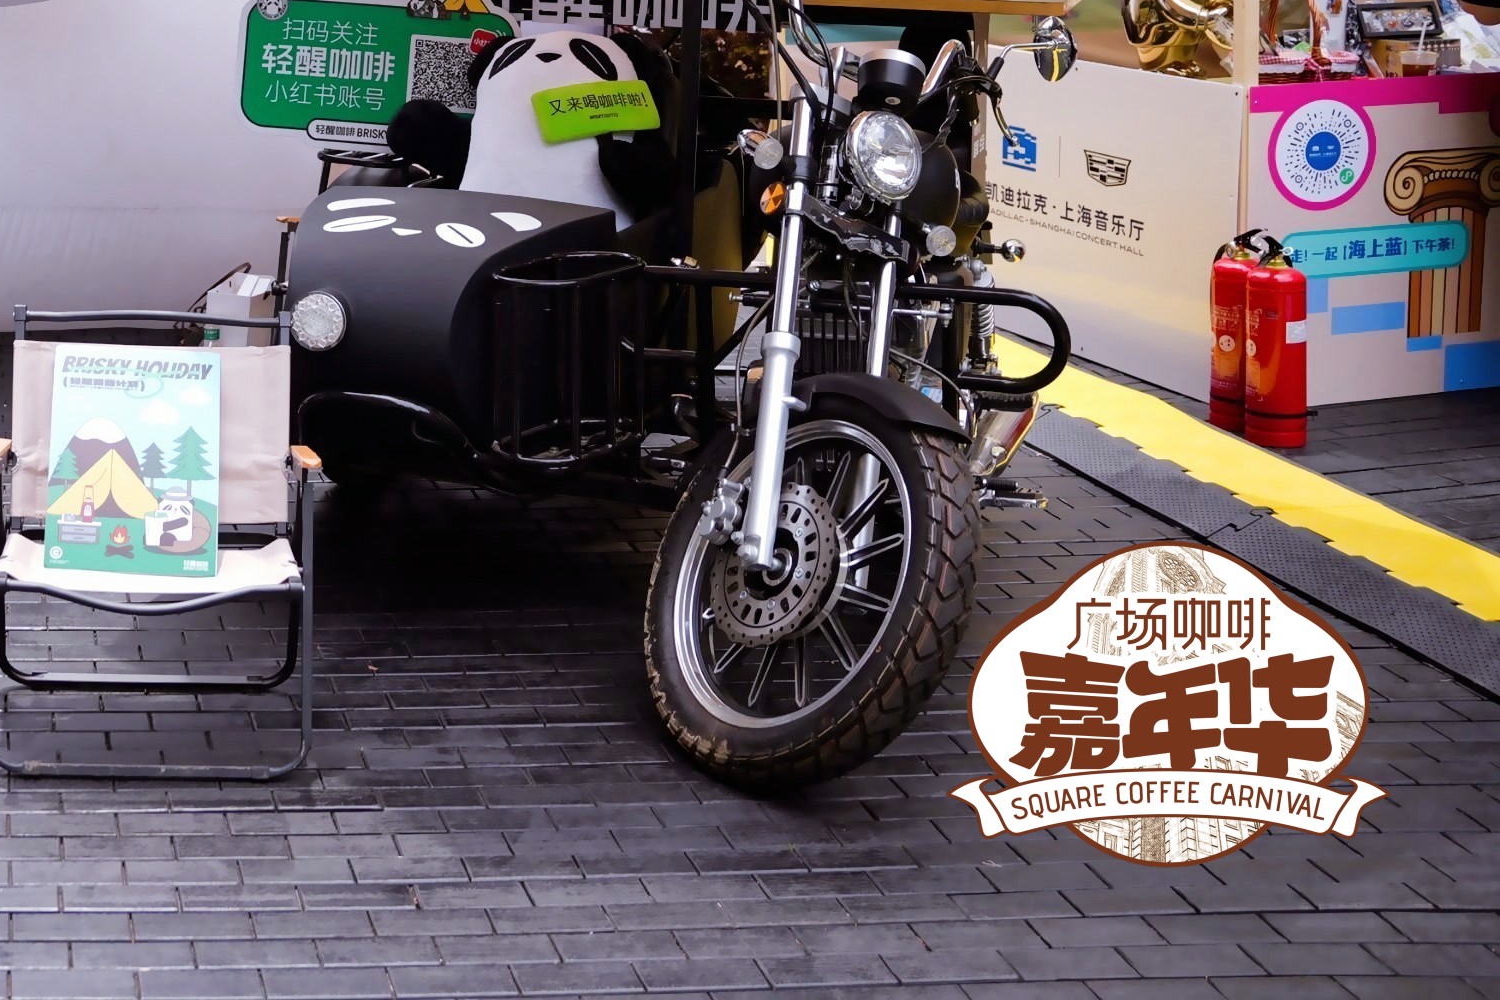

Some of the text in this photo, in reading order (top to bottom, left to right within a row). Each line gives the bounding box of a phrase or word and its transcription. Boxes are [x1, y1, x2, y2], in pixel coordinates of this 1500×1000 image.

[283, 17, 379, 46] 扫码关注
[261, 43, 396, 82] 轻醒咖啡
[265, 80, 386, 111] 小红书账号
[315, 124, 356, 137] 轻醒咖啡
[990, 208, 1145, 257] ADILLAC SHANGHAI CONCERT HALL
[1311, 246, 1338, 261] 一起
[62, 355, 213, 381] BRISKY HOLIDAY
